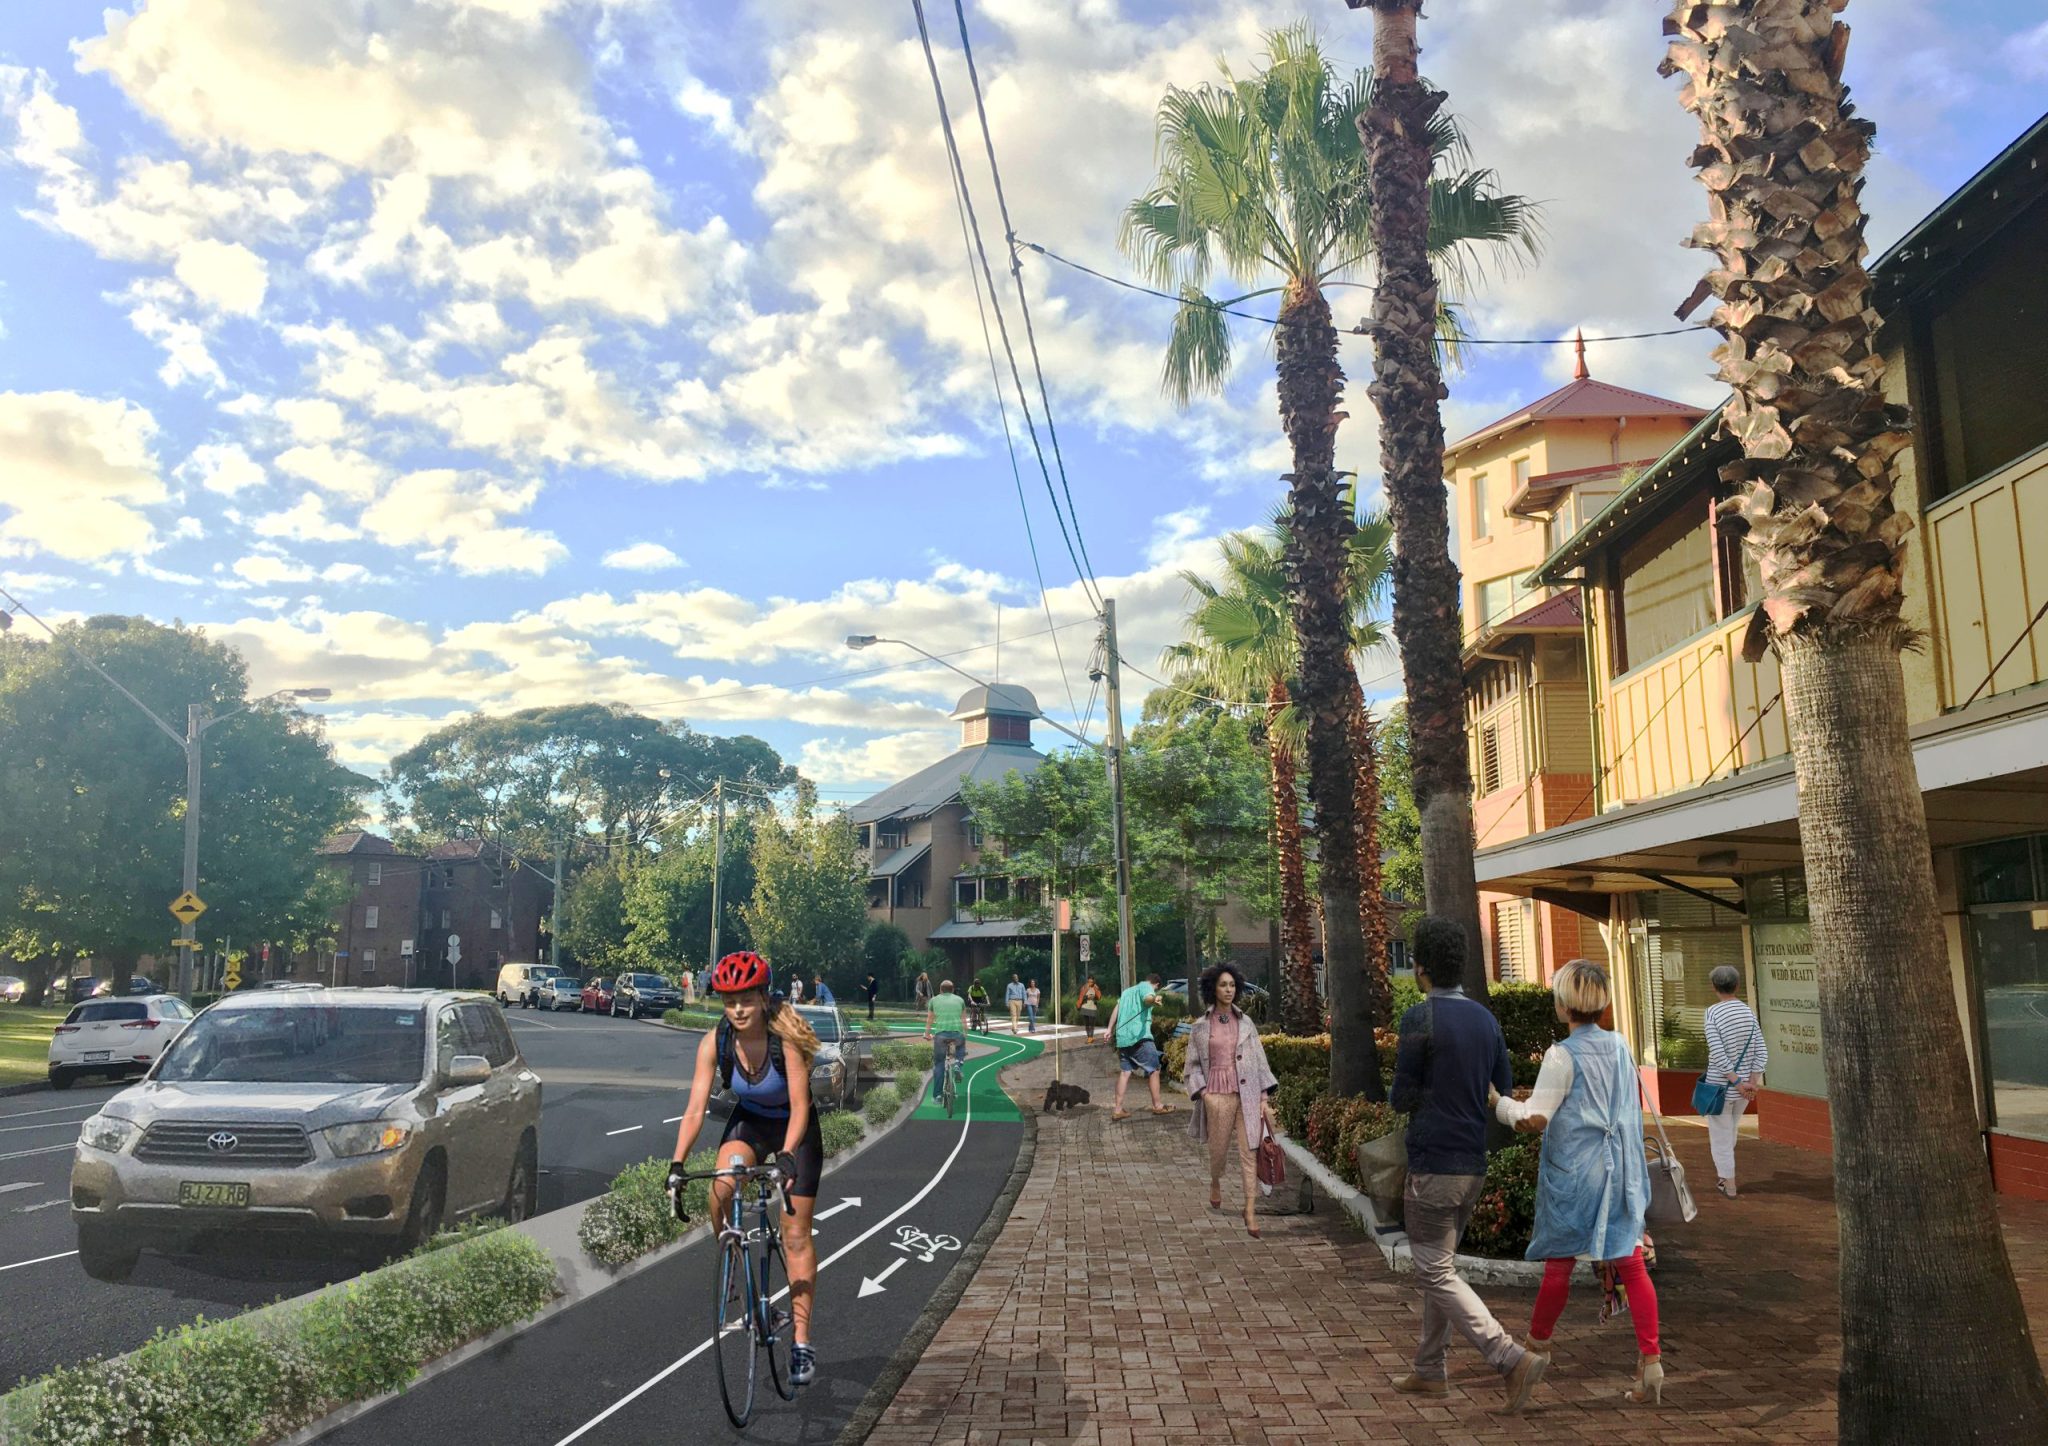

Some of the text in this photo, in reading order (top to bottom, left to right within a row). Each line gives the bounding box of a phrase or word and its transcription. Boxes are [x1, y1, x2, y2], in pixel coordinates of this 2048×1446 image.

[1765, 943, 1786, 956] STRATA
[1771, 969, 1814, 981] WEDD REALTY
